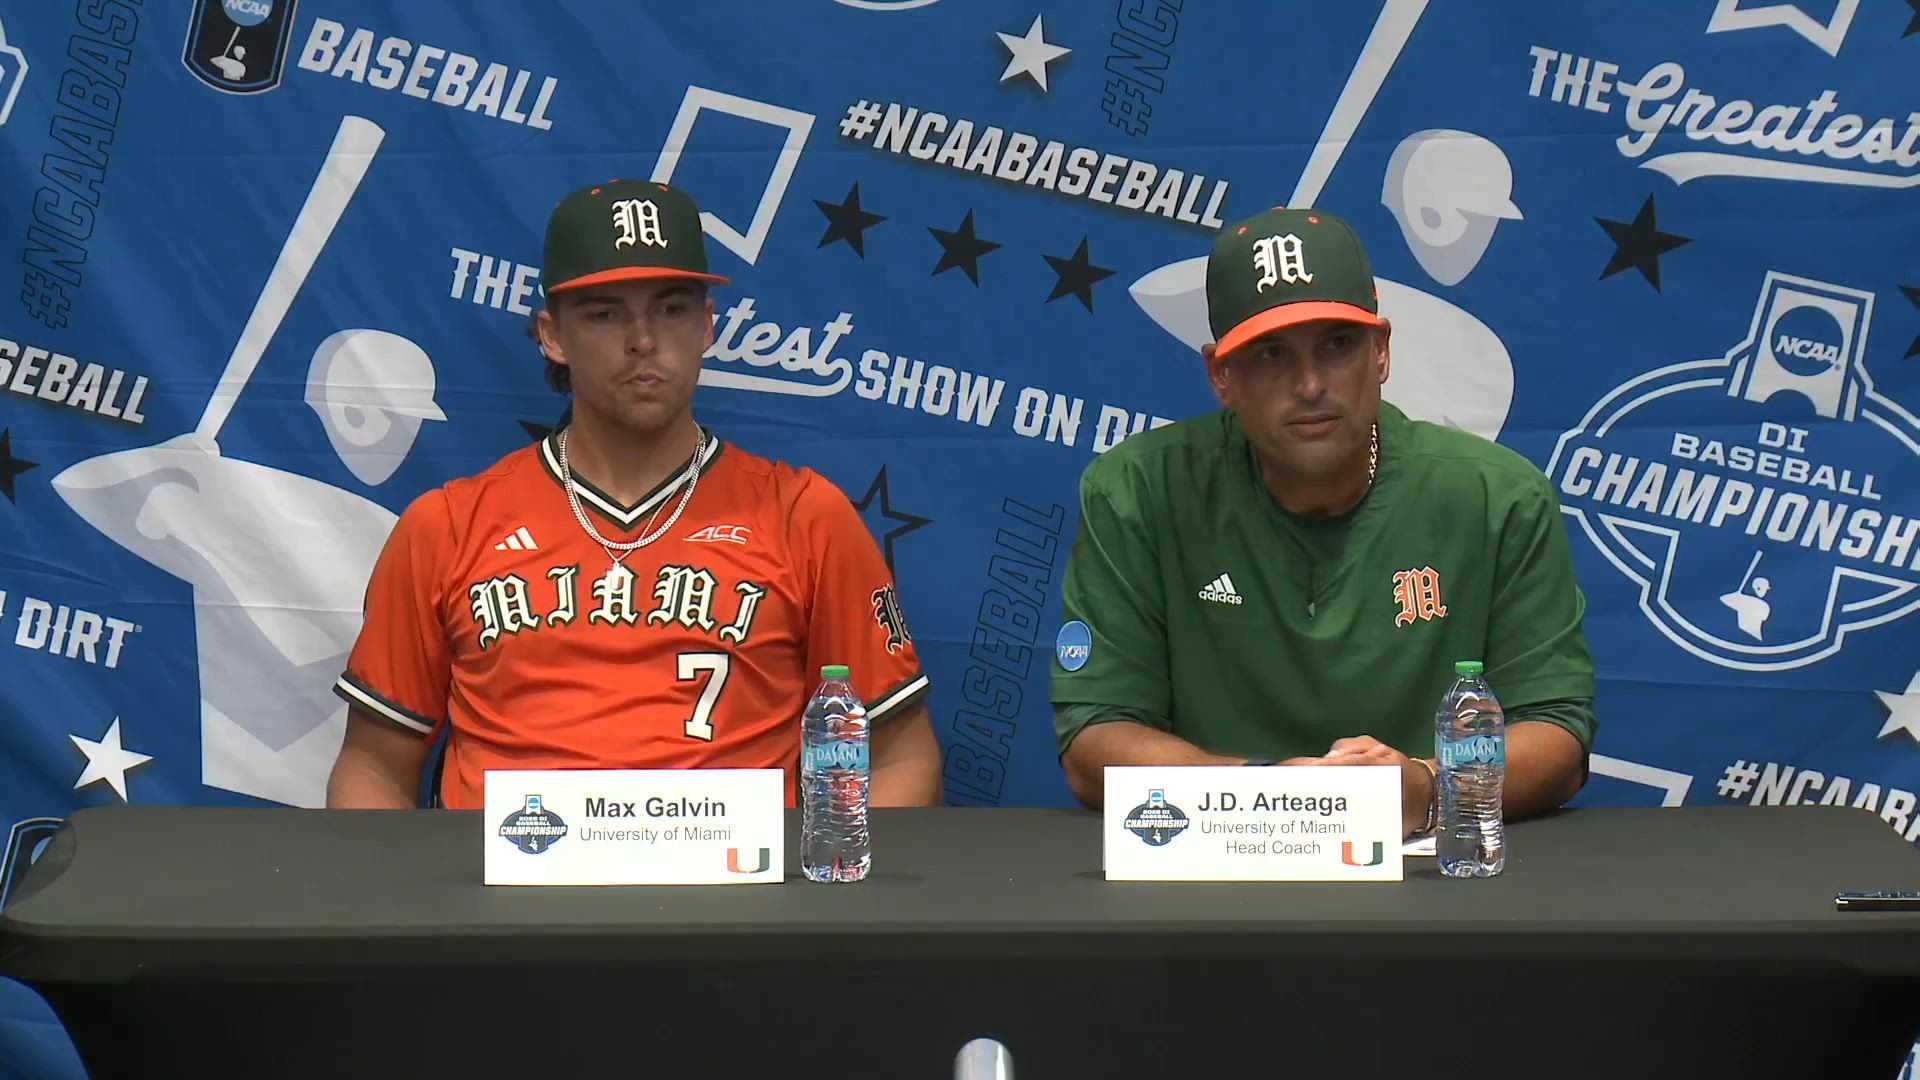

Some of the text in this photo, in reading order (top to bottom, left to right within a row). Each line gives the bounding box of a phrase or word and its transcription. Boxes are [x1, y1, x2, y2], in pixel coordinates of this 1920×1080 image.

[298, 17, 558, 130] BASEBALL
[1101, 0, 1183, 137] #NC
[1528, 46, 1619, 113] THE
[21, 0, 143, 330] #NCAABAS
[840, 98, 1229, 228] #NCAABASEBALL
[612, 198, 669, 250] M
[1252, 232, 1314, 294] M
[450, 247, 541, 316] THE
[854, 349, 1004, 428] SHOW
[1014, 386, 1084, 447] ON
[1775, 334, 1839, 364] NCAA
[1758, 422, 1809, 453] DI
[1671, 432, 1883, 500] BASEBALL
[1560, 446, 1920, 571] CHAMPIONSH
[682, 525, 752, 544] ACC
[469, 563, 766, 650] MIAMI
[1198, 590, 1243, 605] adidas
[1392, 565, 1448, 628] M
[15, 597, 135, 668] DIRT
[943, 497, 1065, 807] BASEBALL
[1060, 645, 1089, 658] NCAA
[677, 652, 730, 741] 7
[816, 745, 857, 766] DASANI
[1455, 740, 1495, 760] DASANI
[585, 796, 726, 818] Max Galvin
[1198, 792, 1348, 816] J.D. Arteaga
[500, 825, 567, 836] CHAMPIONSHIP
[580, 826, 731, 844] University of Miami
[1125, 818, 1188, 829] CHAMPIONSHIP
[1201, 820, 1345, 837] University of Miami
[727, 847, 770, 873] U
[1226, 840, 1321, 854] Head Coach
[1342, 842, 1383, 866] U
